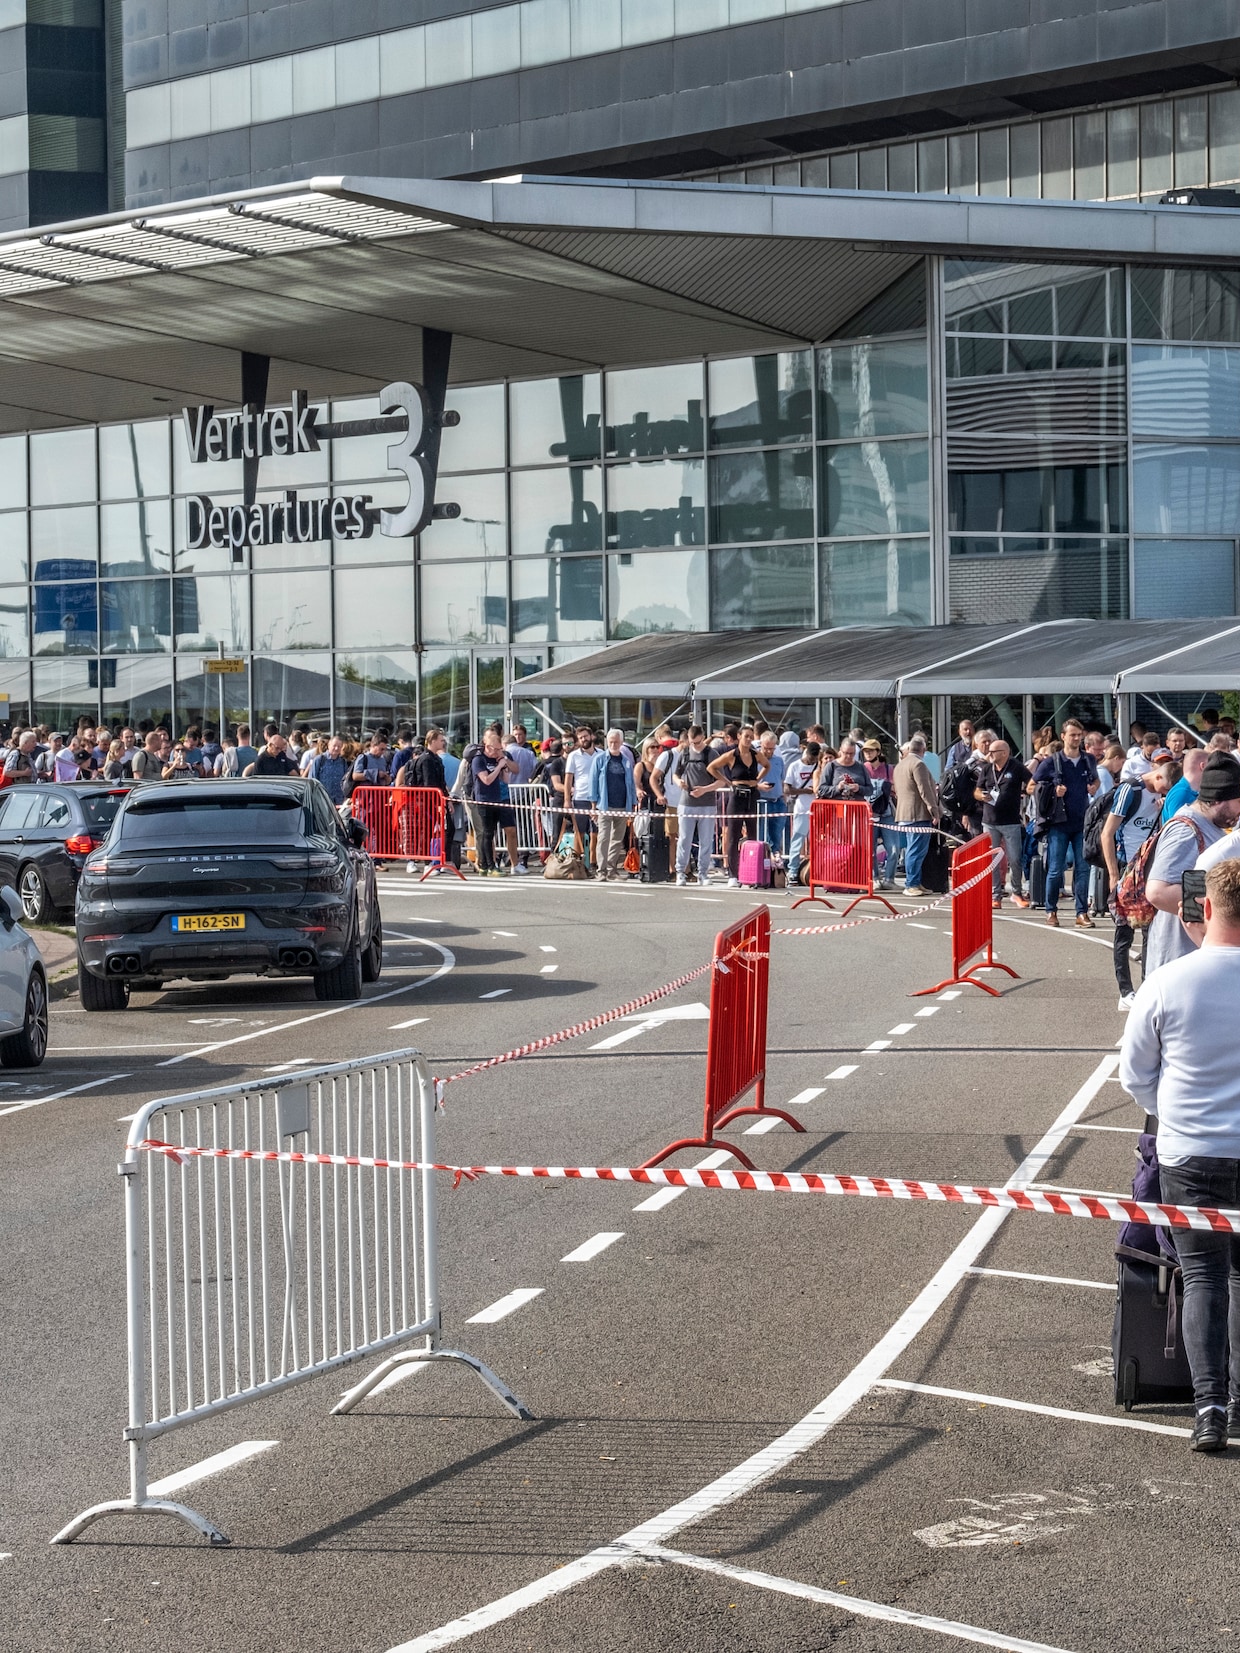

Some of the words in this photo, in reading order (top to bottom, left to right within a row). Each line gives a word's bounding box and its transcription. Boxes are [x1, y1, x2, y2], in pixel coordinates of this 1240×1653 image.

[182, 389, 320, 463] Vertrek
[379, 381, 434, 538] 3
[185, 491, 372, 562] Departures
[183, 916, 239, 929] H-162-SN
